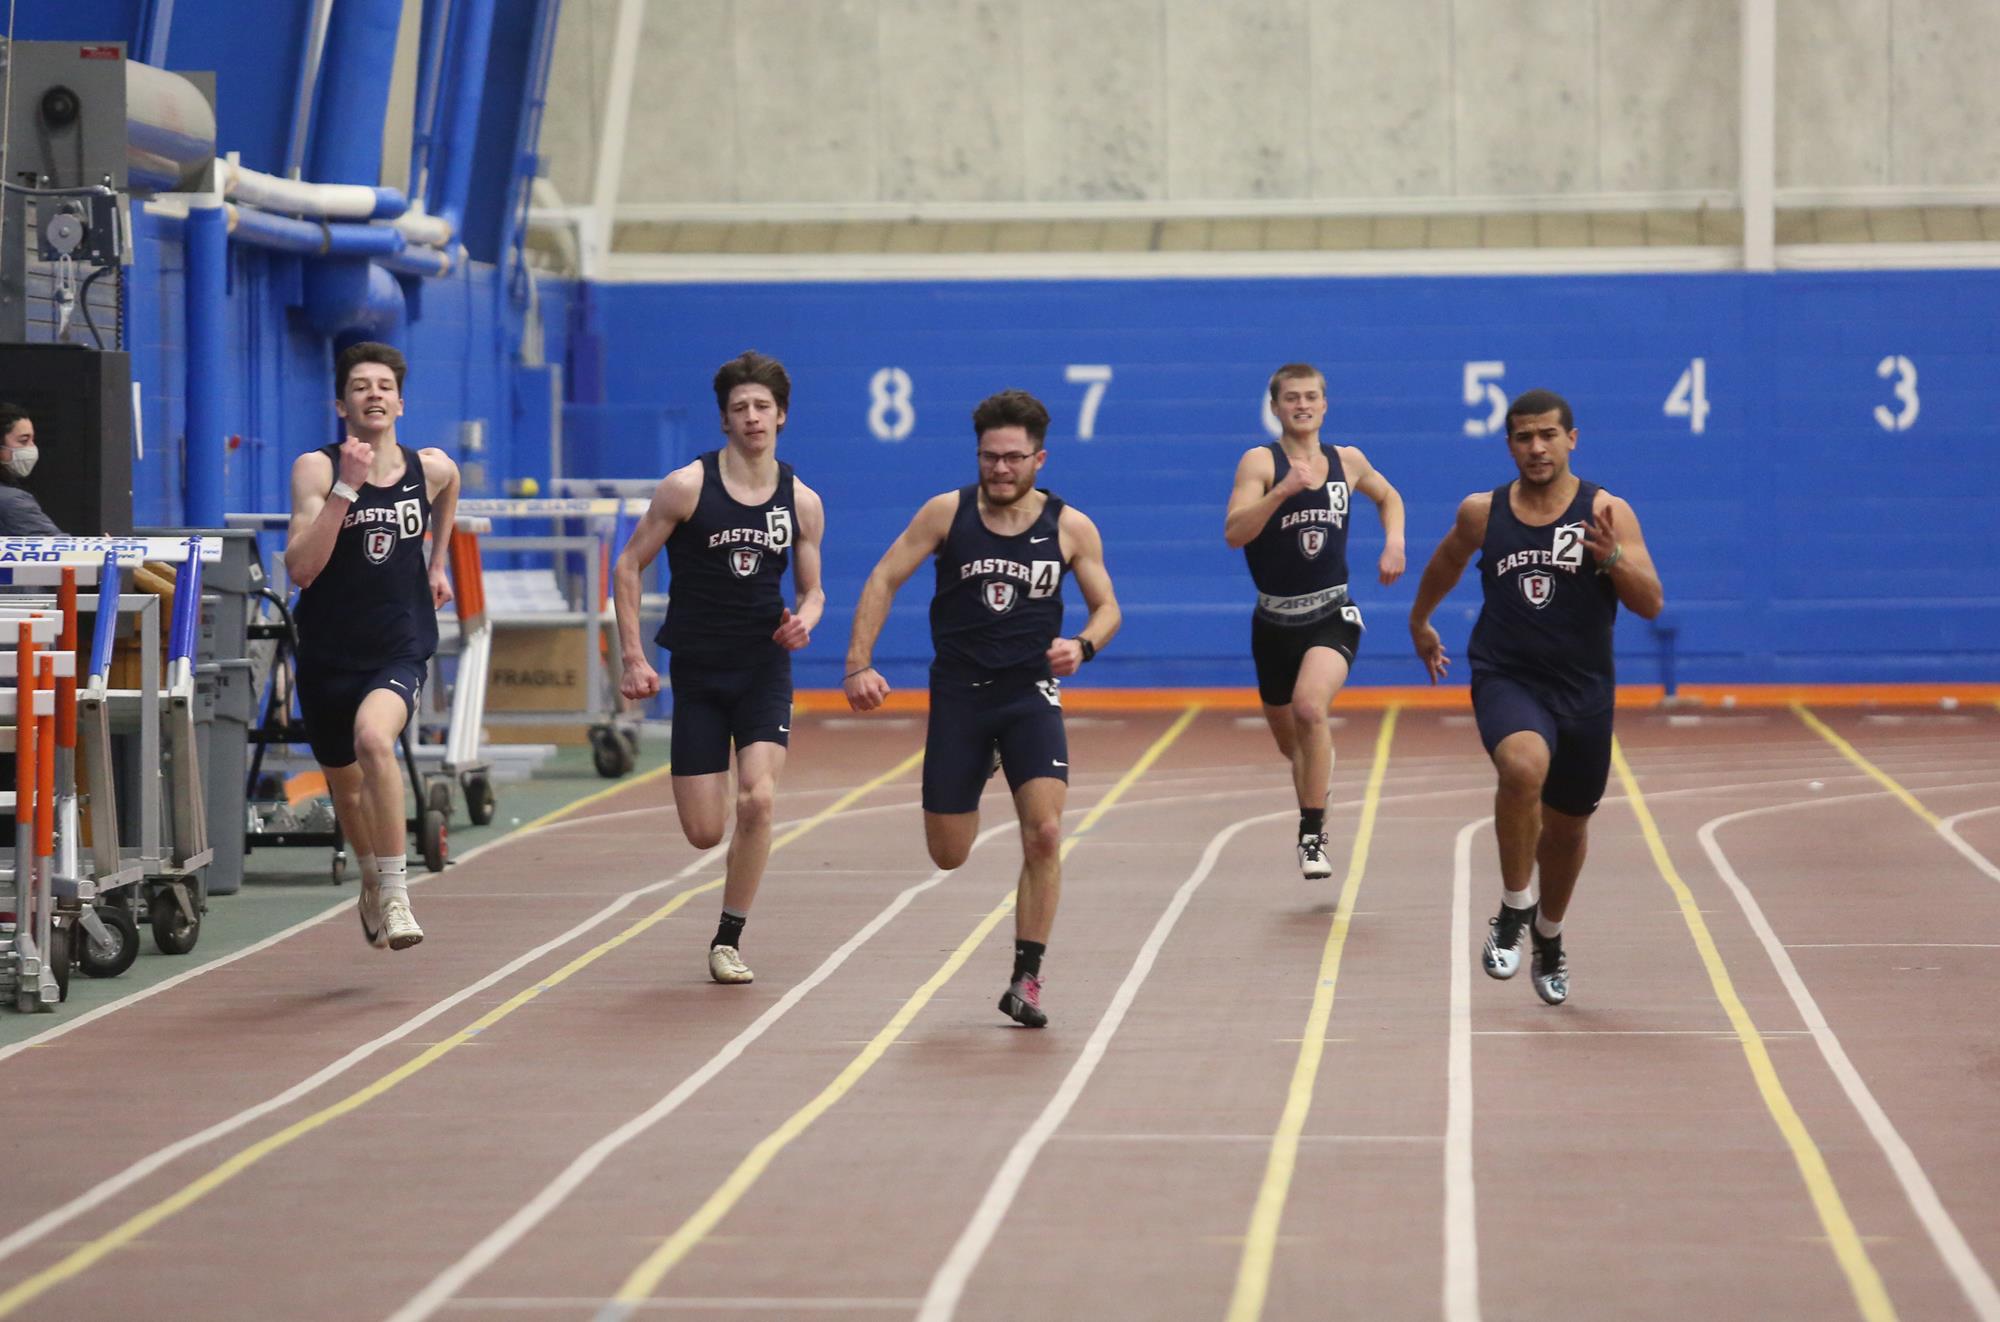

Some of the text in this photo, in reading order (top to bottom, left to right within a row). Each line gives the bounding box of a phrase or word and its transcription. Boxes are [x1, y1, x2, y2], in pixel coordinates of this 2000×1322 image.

[868, 366, 915, 441] 8
[1065, 364, 1112, 440] 7
[1463, 360, 1509, 437] 5
[1663, 357, 1710, 434] 4
[1873, 354, 1919, 431] 3
[1332, 484, 1345, 511] 3
[343, 507, 400, 528] EASTE
[402, 502, 420, 535] 6
[771, 514, 788, 546] 5
[373, 535, 385, 554] E
[1556, 530, 1578, 563] 2
[740, 553, 751, 571] E
[960, 558, 1033, 583] EASTER
[993, 585, 1006, 605] E
[1034, 564, 1053, 595] 4
[1531, 579, 1544, 598] E
[493, 668, 577, 686] FRAGILE
